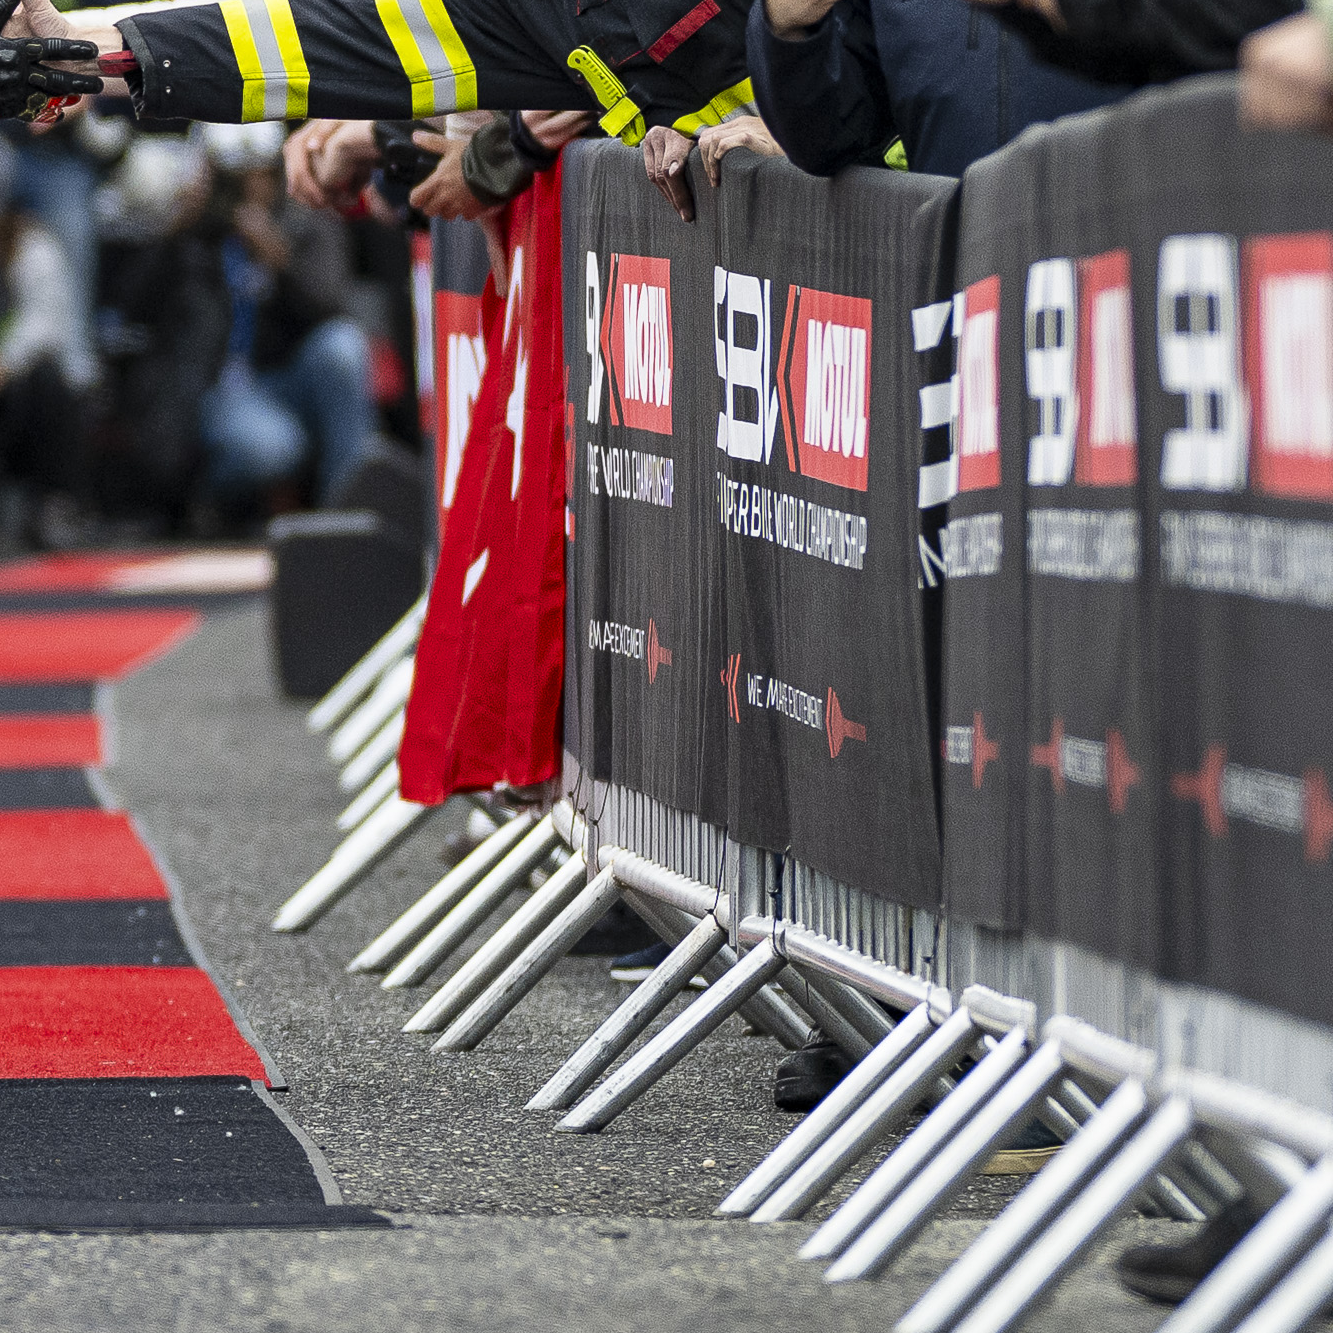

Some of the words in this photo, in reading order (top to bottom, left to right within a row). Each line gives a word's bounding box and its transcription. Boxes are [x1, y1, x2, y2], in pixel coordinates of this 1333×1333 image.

[623, 283, 671, 407] MOTUL
[804, 319, 867, 458] MOTUL
[747, 672, 764, 708] WE
